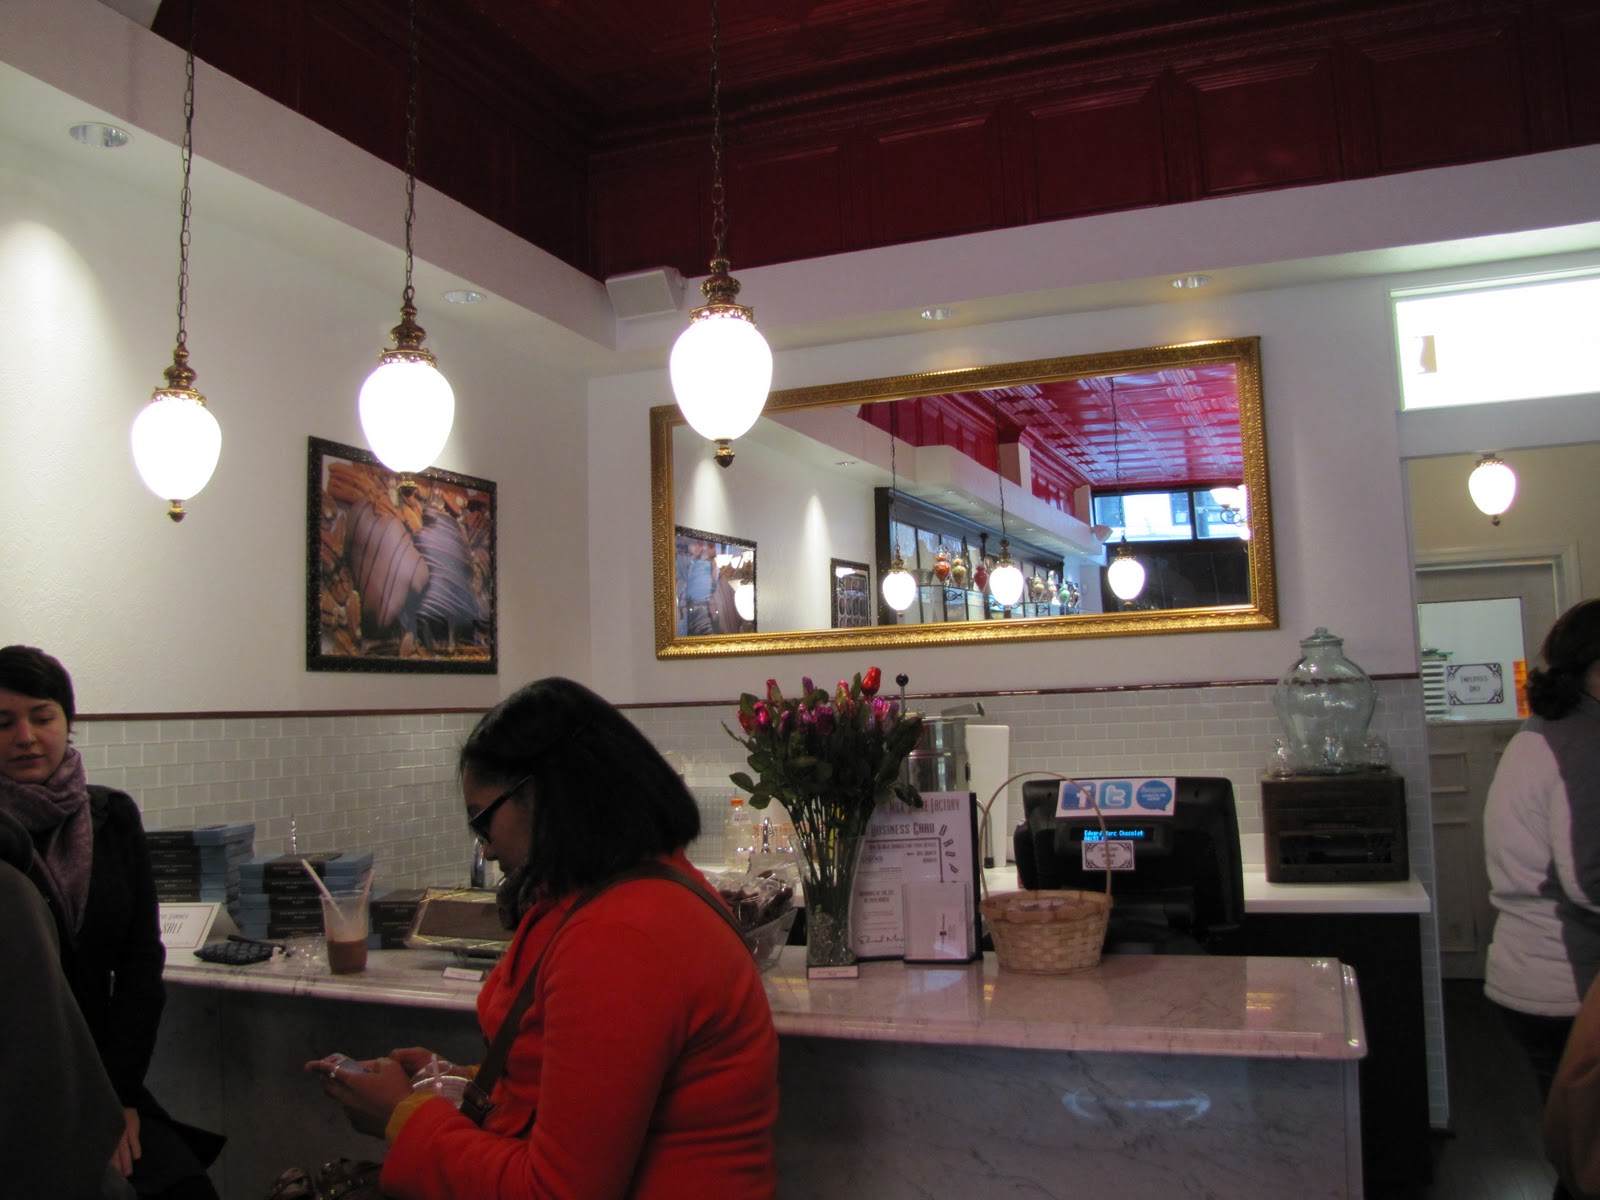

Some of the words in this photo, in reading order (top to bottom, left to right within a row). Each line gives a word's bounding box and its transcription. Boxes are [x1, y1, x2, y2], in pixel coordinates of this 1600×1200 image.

[1460, 675, 1488, 683] EMPLOYEES
[1469, 685, 1481, 693] ONLY
[930, 798, 960, 814] FACTORY
[871, 823, 910, 837] BUSINESS
[913, 822, 935, 835] CARD
[161, 922, 184, 934] SALE
